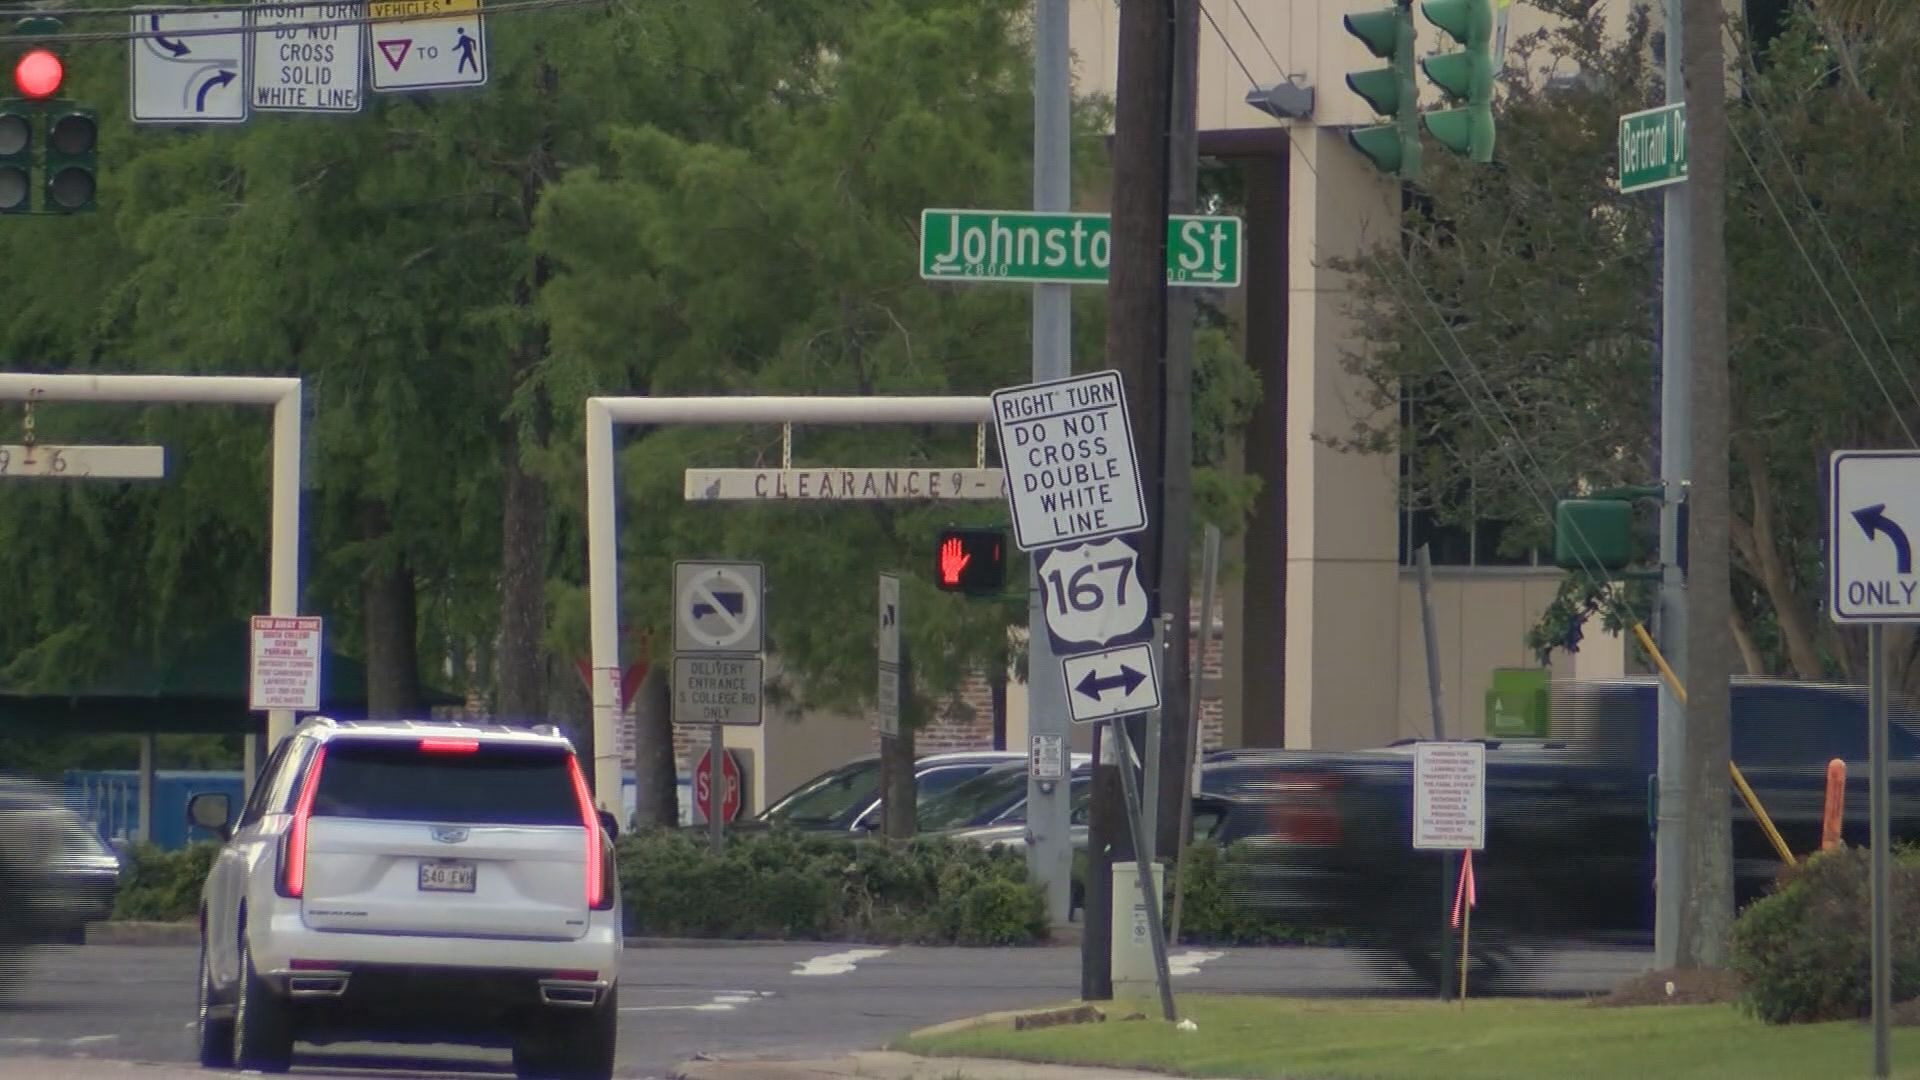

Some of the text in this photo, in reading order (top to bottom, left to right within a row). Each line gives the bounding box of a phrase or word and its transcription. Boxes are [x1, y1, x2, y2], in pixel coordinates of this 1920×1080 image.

[319, 2, 361, 19] TURN
[375, 1, 441, 17] VEHICLES
[276, 22, 338, 40] DO NOT
[280, 44, 334, 63] CROSS
[417, 46, 438, 60] TO
[281, 66, 332, 85] SOLID
[258, 87, 354, 107] WHITE LINE
[1623, 109, 1687, 173] Bertrand Dr
[935, 214, 1227, 271] Johnsto St
[965, 263, 1008, 277] 2800
[1002, 382, 1115, 420] RIGHT TURN
[1014, 412, 1109, 447] DO NOT
[1028, 437, 1108, 467] CROSS
[754, 470, 941, 499] CLEARANCE
[1024, 458, 1121, 493] DOUBLE
[1040, 484, 1113, 513] WHITE
[1053, 510, 1108, 537] LINE
[1048, 556, 1134, 616] 167
[1848, 580, 1918, 606] ONLY
[690, 661, 745, 675] DELIVERY
[688, 677, 747, 691] ENTRANCE
[691, 691, 739, 705] COLLEGE
[742, 692, 756, 705] RD
[703, 707, 731, 719] ONLY
